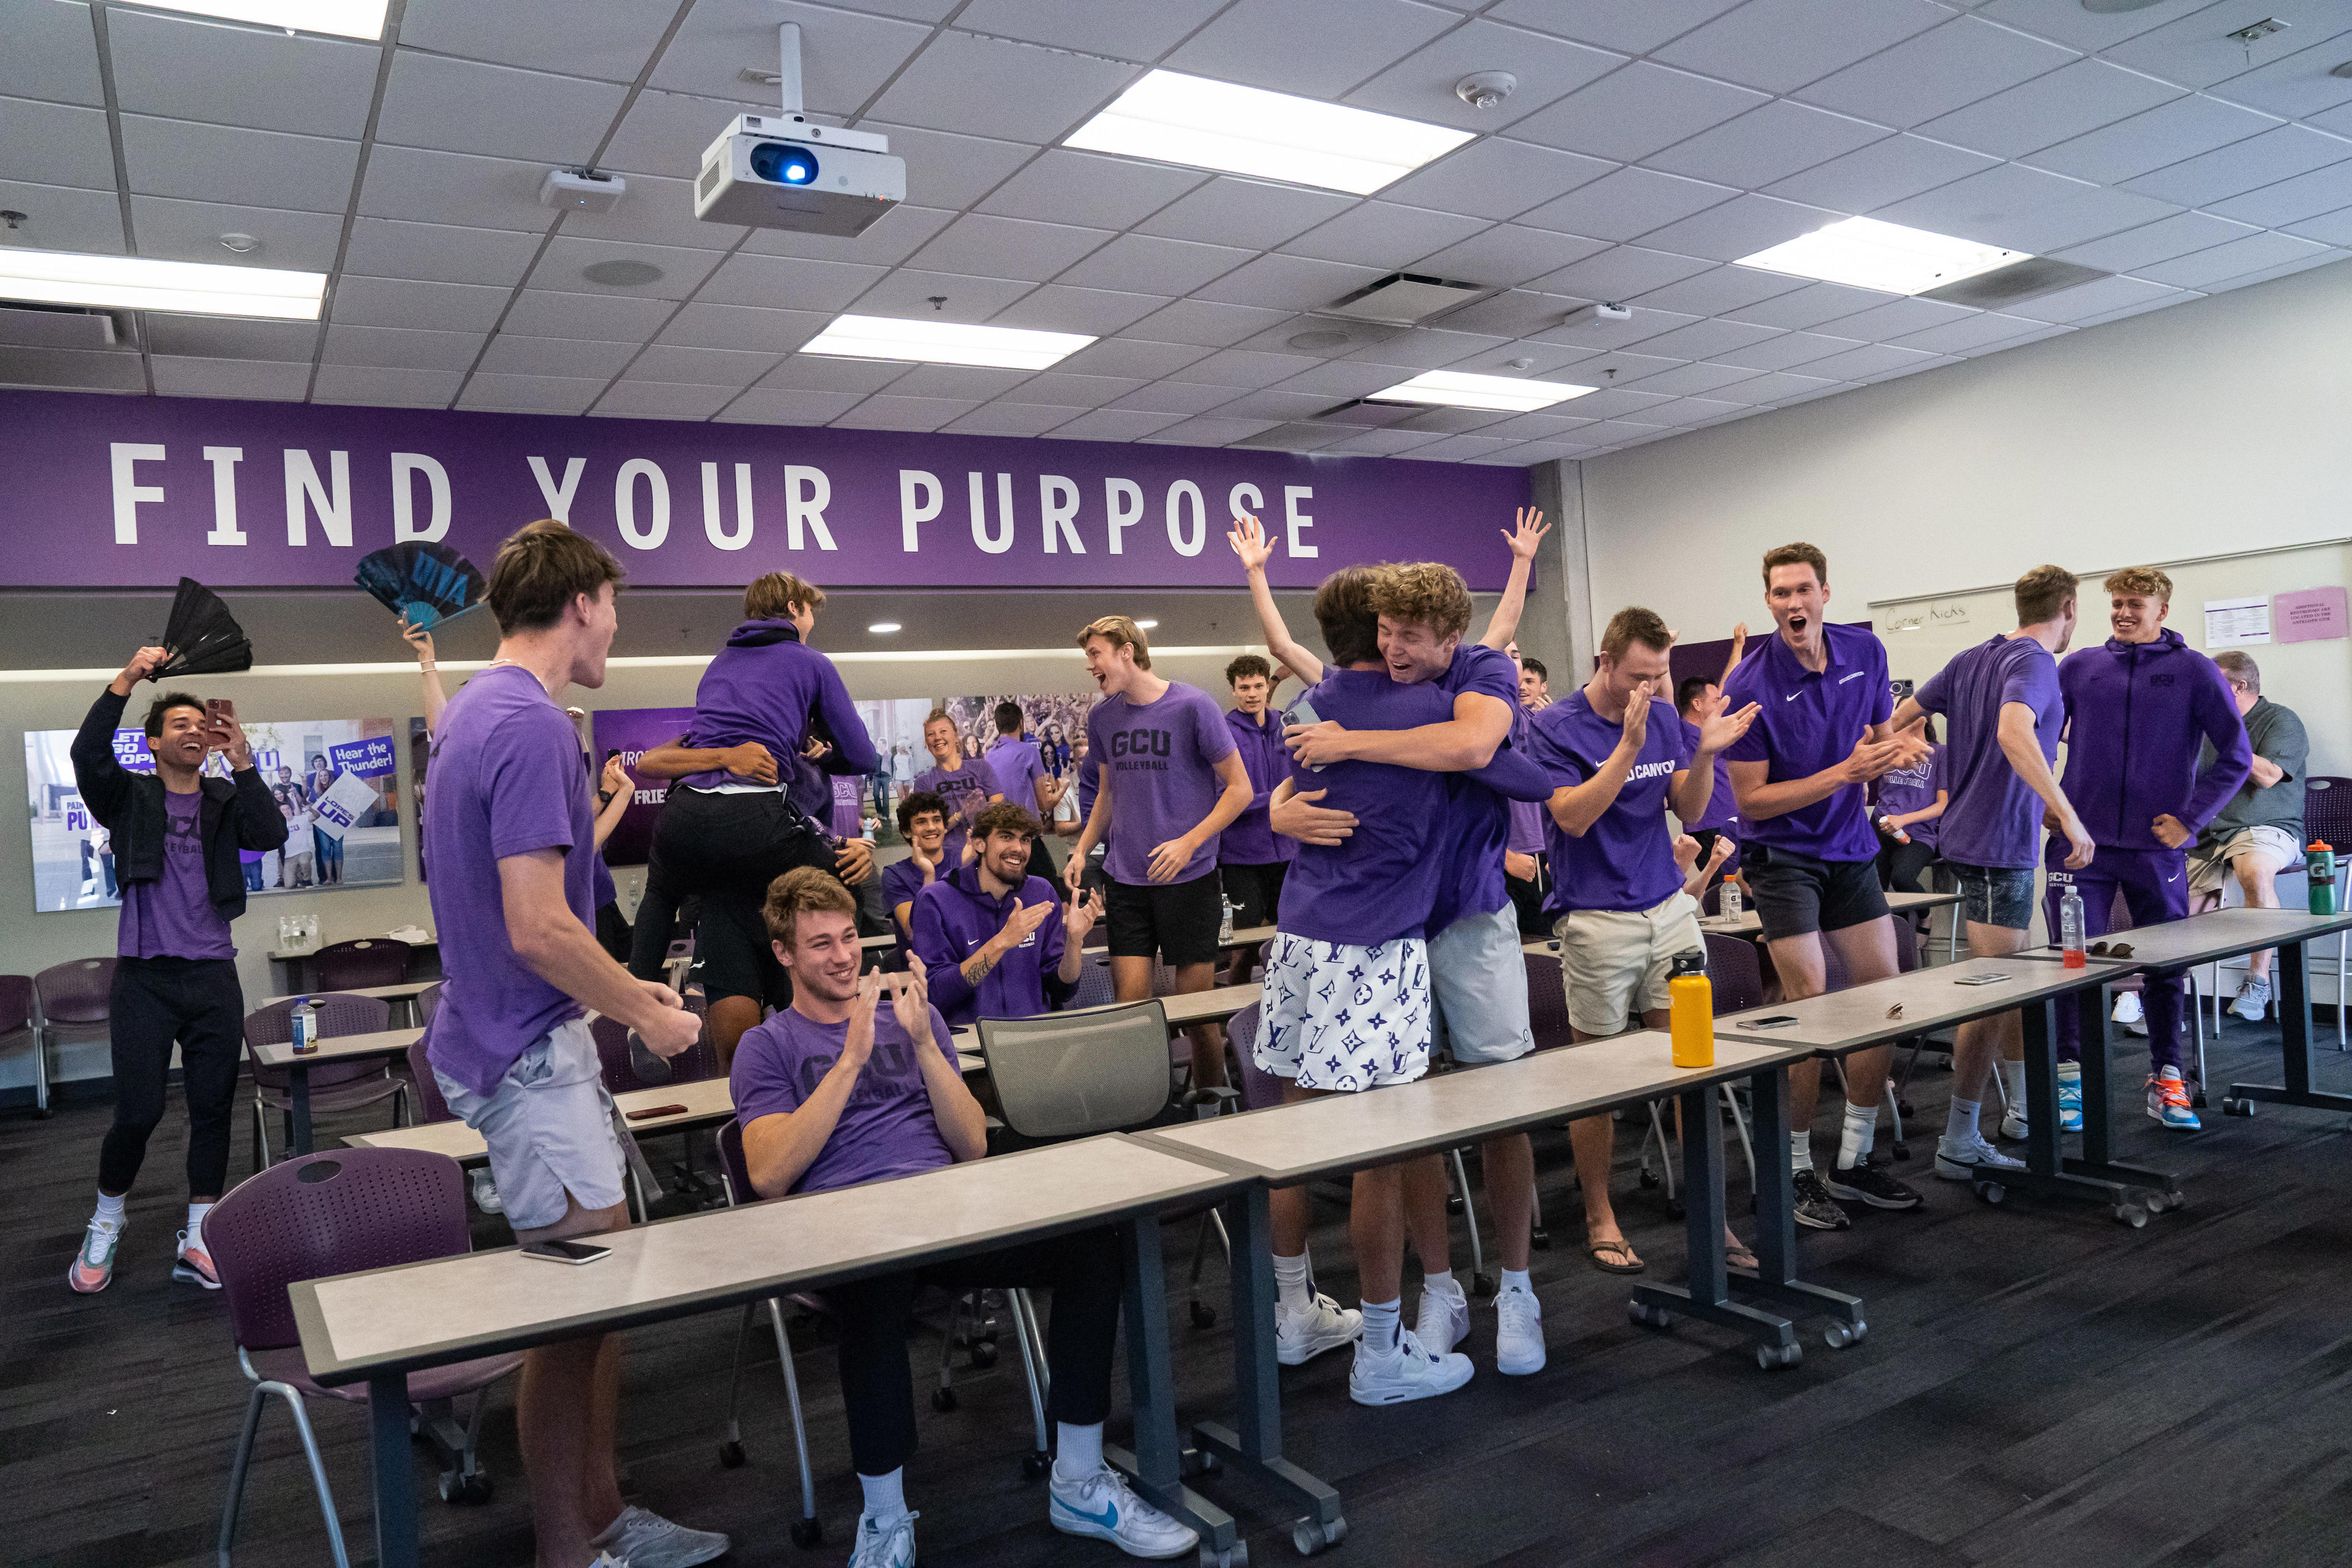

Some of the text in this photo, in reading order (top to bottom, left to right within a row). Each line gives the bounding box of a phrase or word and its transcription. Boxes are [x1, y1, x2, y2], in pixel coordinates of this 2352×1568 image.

[110, 442, 1319, 558] FIND YOUR PURPOSE
[1885, 602, 1966, 630] Corner Kicks
[336, 742, 387, 761] Hear the
[1112, 729, 1171, 758] GCU
[338, 754, 393, 772] Thunder!
[1116, 761, 1169, 771] VOLLEYBALL
[936, 777, 976, 794] GCU
[634, 788, 668, 805] FRIE
[317, 801, 351, 828] UP
[324, 796, 355, 820] LOPES
[2048, 872, 2074, 883] GCU
